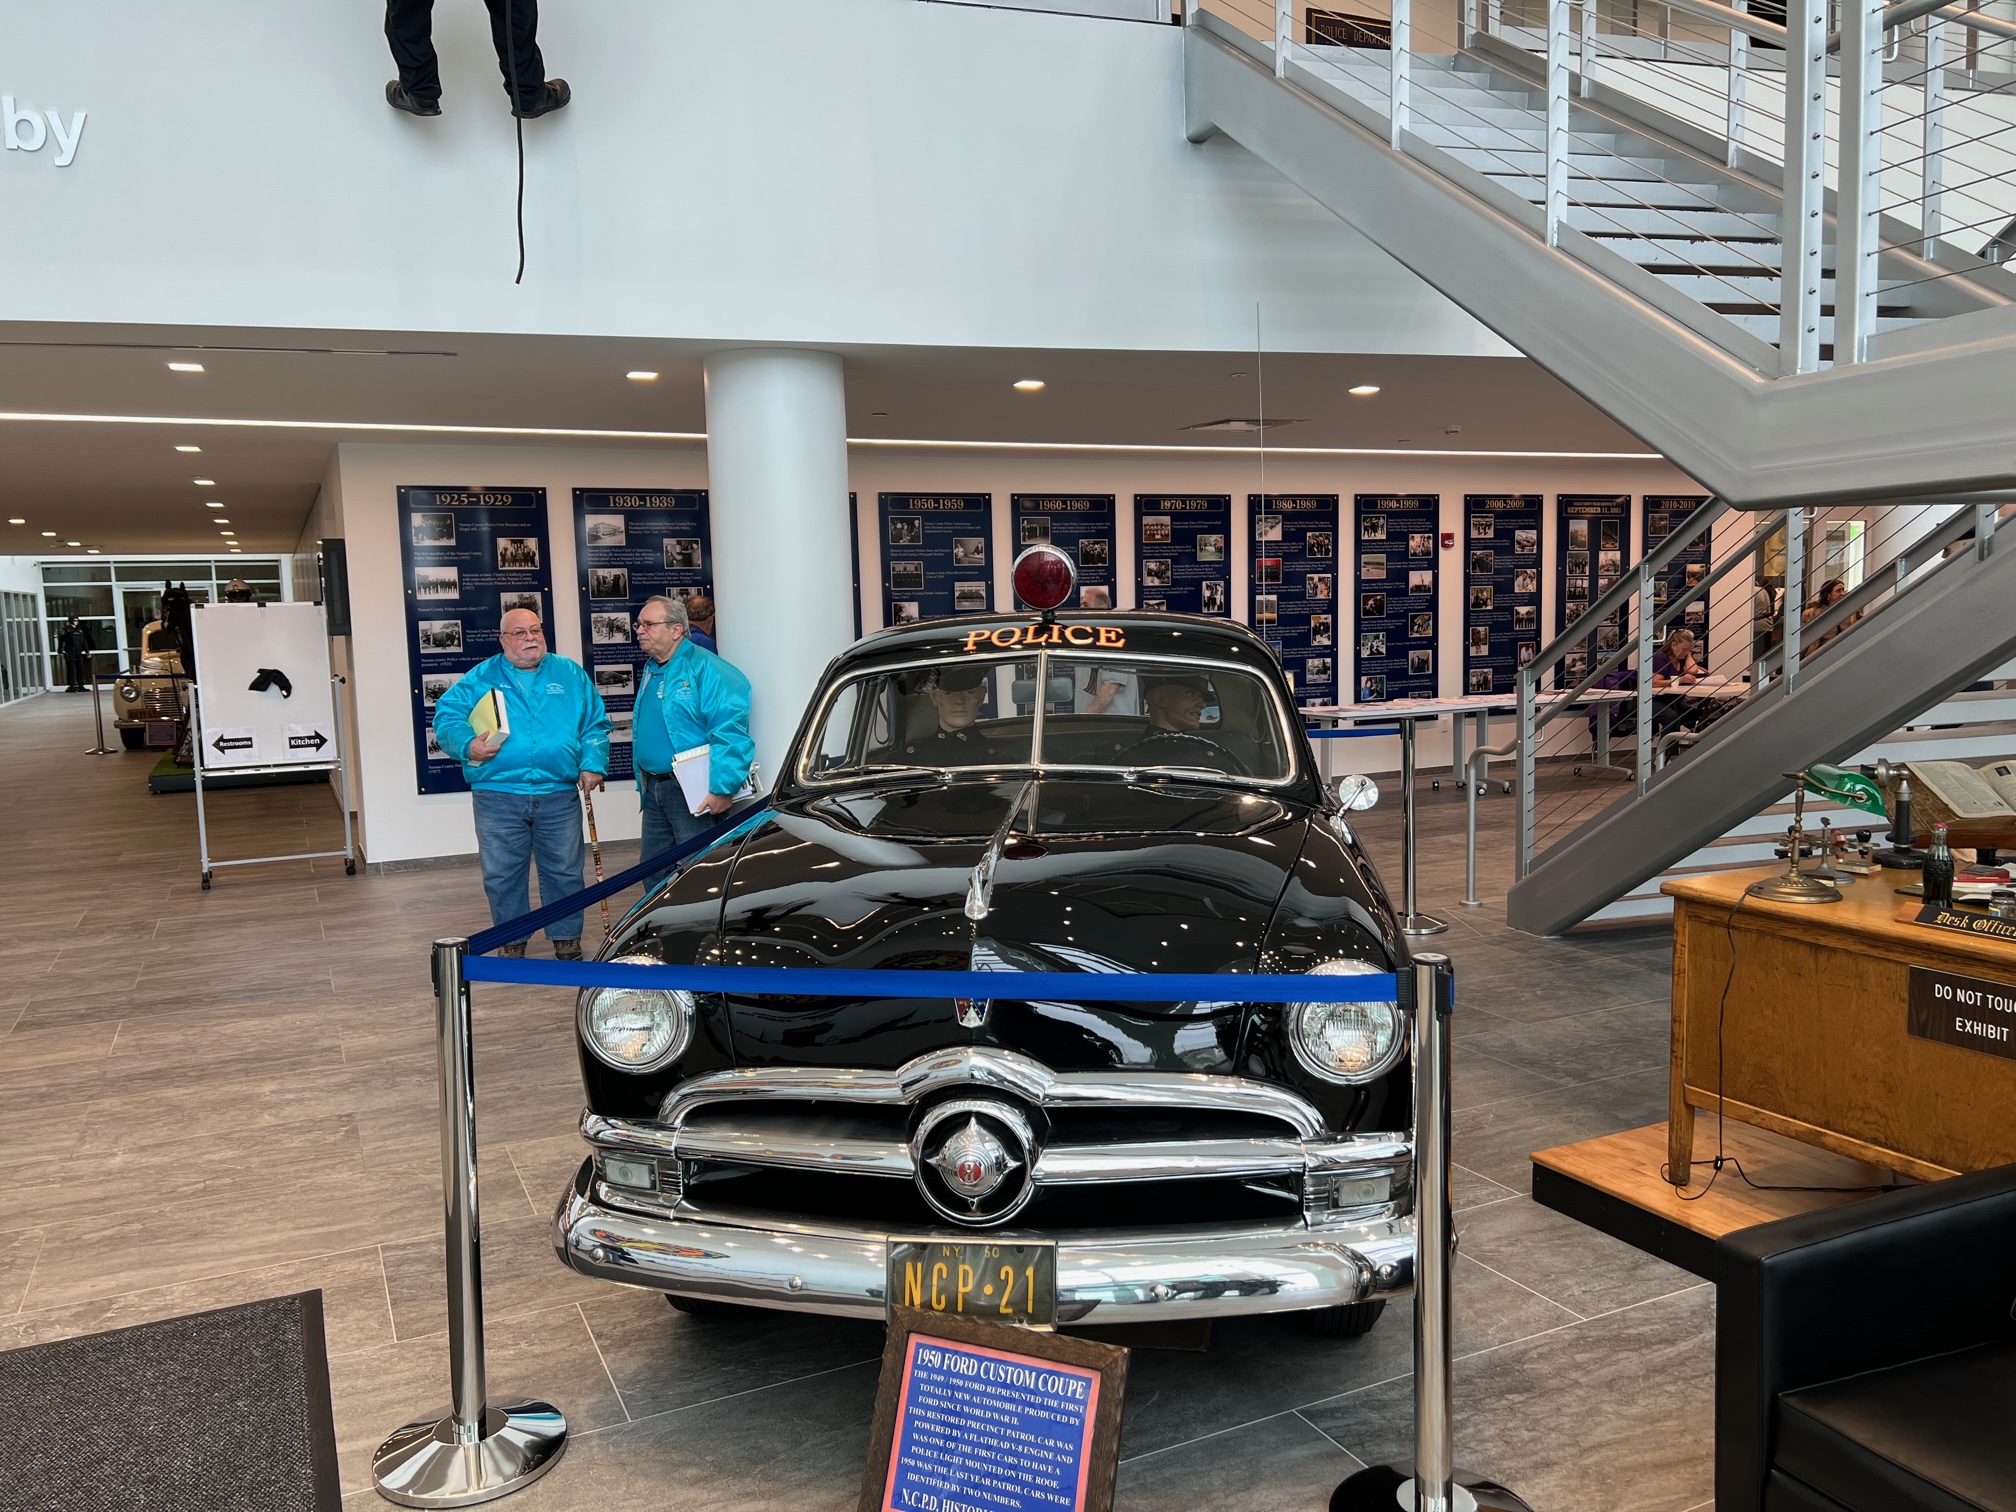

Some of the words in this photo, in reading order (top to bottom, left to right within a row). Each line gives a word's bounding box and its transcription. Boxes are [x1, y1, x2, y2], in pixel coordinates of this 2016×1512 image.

[1320, 24, 1347, 40] POLICE
[1, 95, 87, 167] by
[434, 493, 513, 505] 1925-1929
[608, 495, 675, 507] 1930-1939
[908, 498, 964, 510] 1950-1959
[1038, 500, 1090, 511] 1960-1969
[1159, 500, 1208, 510] 1970-1979
[1272, 499, 1317, 509] 1980-1989
[1377, 499, 1419, 509] 1990-1999
[1485, 499, 1525, 509] 2000-2009
[1661, 500, 1696, 509] 2010-2019
[963, 624, 1127, 651] POLICE
[290, 738, 320, 746] Kitchen
[1933, 911, 1970, 928] Desk
[1934, 983, 1952, 1000] DO
[1956, 988, 1982, 1006] NOT
[1955, 1017, 2010, 1042] EXHIBIT
[942, 1246, 961, 1257] NY
[917, 1348, 941, 1369] 1950
[943, 1353, 978, 1376] FORD
[980, 1361, 1037, 1389] CUSTOM
[1038, 1373, 1086, 1400] COUPE
[914, 1369, 928, 1380] THE
[930, 1373, 944, 1383] 1949
[949, 1377, 964, 1387] 1950
[964, 1381, 985, 1392] FORD
[986, 1385, 1042, 1404] REPRESENTED
[1043, 1397, 1059, 1408] THE
[1061, 1401, 1085, 1413] FIRST
[918, 1395, 939, 1406] FORD
[940, 1400, 962, 1412] SINCE
[962, 1405, 991, 1419] WORLD
[993, 1412, 1010, 1423] WAR
[1011, 1417, 1019, 1425] II.
[919, 1383, 953, 1398] TOTALLY
[953, 1390, 971, 1401] NEW
[971, 1396, 1023, 1413] AUTOMOBILE
[1024, 1407, 1068, 1423] PRODUCED
[1069, 1417, 1081, 1426] BY
[908, 1406, 926, 1417] THIS
[926, 1411, 966, 1426] RESTORED
[966, 1420, 1006, 1435] PRECINCT
[1006, 1429, 1037, 1443] PATROL
[1037, 1436, 1055, 1448] CAR
[1056, 1440, 1073, 1451] WAS
[912, 1432, 928, 1443] WAS
[929, 1437, 945, 1447] ONE
[946, 1440, 956, 1450] OF
[957, 1443, 973, 1454] THE
[974, 1447, 996, 1460] FIRST
[997, 1453, 1018, 1465] CARS
[1020, 1459, 1031, 1467] TO
[1032, 1462, 1053, 1473] HAVE
[914, 1420, 951, 1435] POWERED
[952, 1429, 962, 1438] BY
[969, 1433, 1010, 1449] FLATHEAD
[1011, 1443, 1023, 1452] V-8
[1024, 1446, 1054, 1460] ENGINE
[1055, 1454, 1073, 1465] AND
[911, 1445, 939, 1459] POLICE
[940, 1453, 964, 1465] LIGHT
[965, 1458, 1003, 1474] MOUNTED
[1004, 1469, 1016, 1478] ON
[1018, 1472, 1034, 1482] THE
[1035, 1476, 1059, 1489] ROOF.
[900, 1457, 916, 1467] 1950
[916, 1460, 933, 1470] WAS
[933, 1465, 948, 1475] THE
[949, 1469, 969, 1480] LAST
[970, 1474, 991, 1486] YEAR
[992, 1479, 1023, 1494] PATROL
[1024, 1487, 1045, 1500] CARS
[1046, 1493, 1071, 1506] WERE
[907, 1472, 950, 1490] IDENTIFIED
[951, 1483, 962, 1493] BY
[963, 1486, 980, 1498] TWO
[982, 1491, 1022, 1509] NUMBERS.
[901, 1488, 939, 1512] N.C.P.D.
